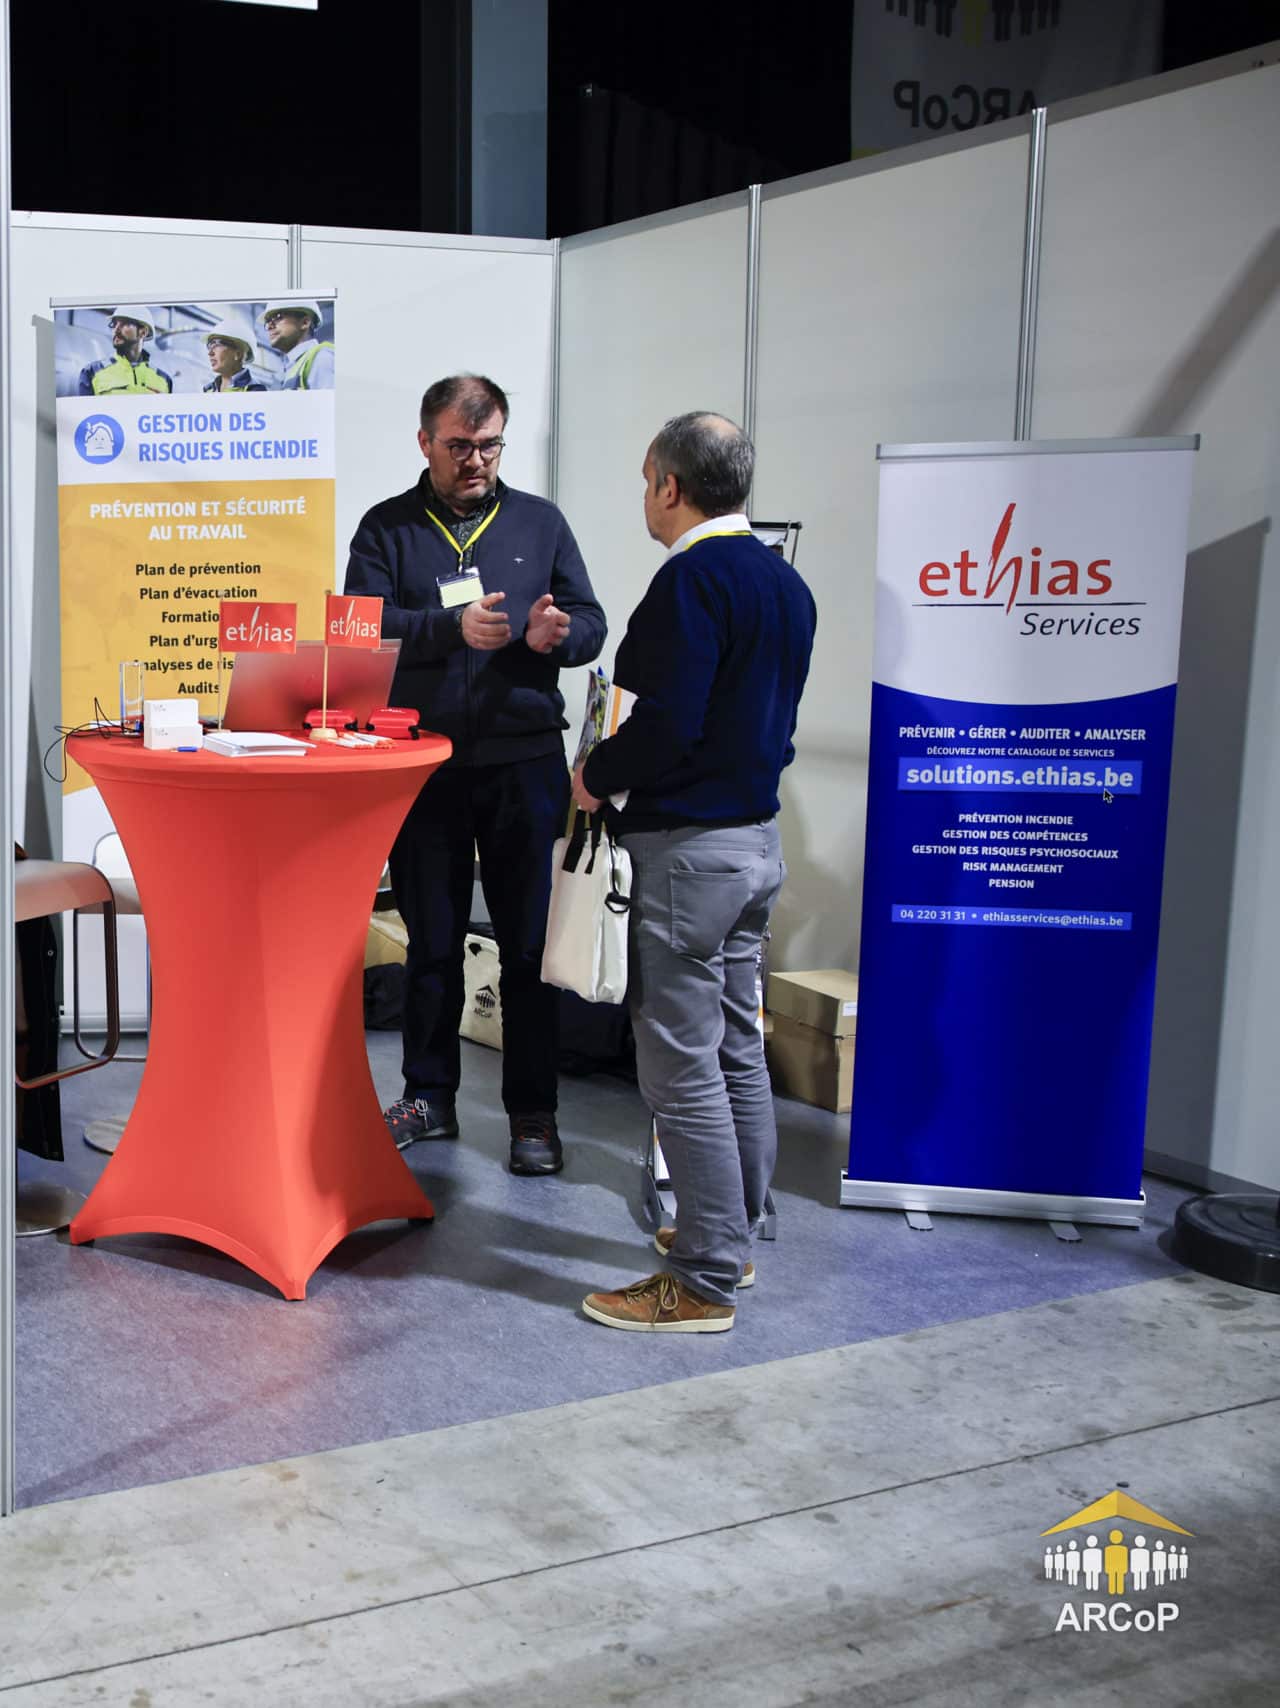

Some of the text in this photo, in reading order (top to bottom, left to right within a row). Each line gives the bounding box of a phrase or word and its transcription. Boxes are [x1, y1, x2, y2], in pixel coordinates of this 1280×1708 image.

[137, 412, 266, 434] GESTION DES
[138, 439, 318, 464] RISQUES INCENDIE
[89, 496, 307, 518] PRÉVENTION ET SÉCURITÉ
[148, 524, 248, 540] AU TRAVAIL
[918, 503, 1113, 616] ethias
[135, 562, 261, 578] Plan de prévention
[140, 587, 169, 600] Plan
[161, 611, 219, 623] Formatio
[330, 599, 378, 642] ethias
[1020, 611, 1142, 636] Services
[225, 605, 294, 648] ethias
[149, 634, 218, 648] Plan d'urg
[133, 658, 193, 674] nalyses
[197, 658, 213, 670] de
[177, 681, 219, 694] Audits
[899, 725, 1146, 740] PRÉVENIR GÉRER AUDITER ANALYSER
[927, 745, 1115, 758] DÉCOUVREZ NOTRE CATALOGUE DE SERVICES
[906, 764, 1133, 788] solutions.ethias.be
[958, 812, 1074, 825] PRÉVENTION INCENDIE
[942, 829, 1089, 842] GESTION DES COMPÉTENCES
[912, 844, 1119, 859] GESTION DES RISQUES PSYCHOSOCIAUX
[962, 862, 1064, 874] RISK MANAGEMENT
[988, 878, 1035, 889] PENSION
[900, 909, 1124, 927] 04 220 31 31 ethiasservices@ethias.be
